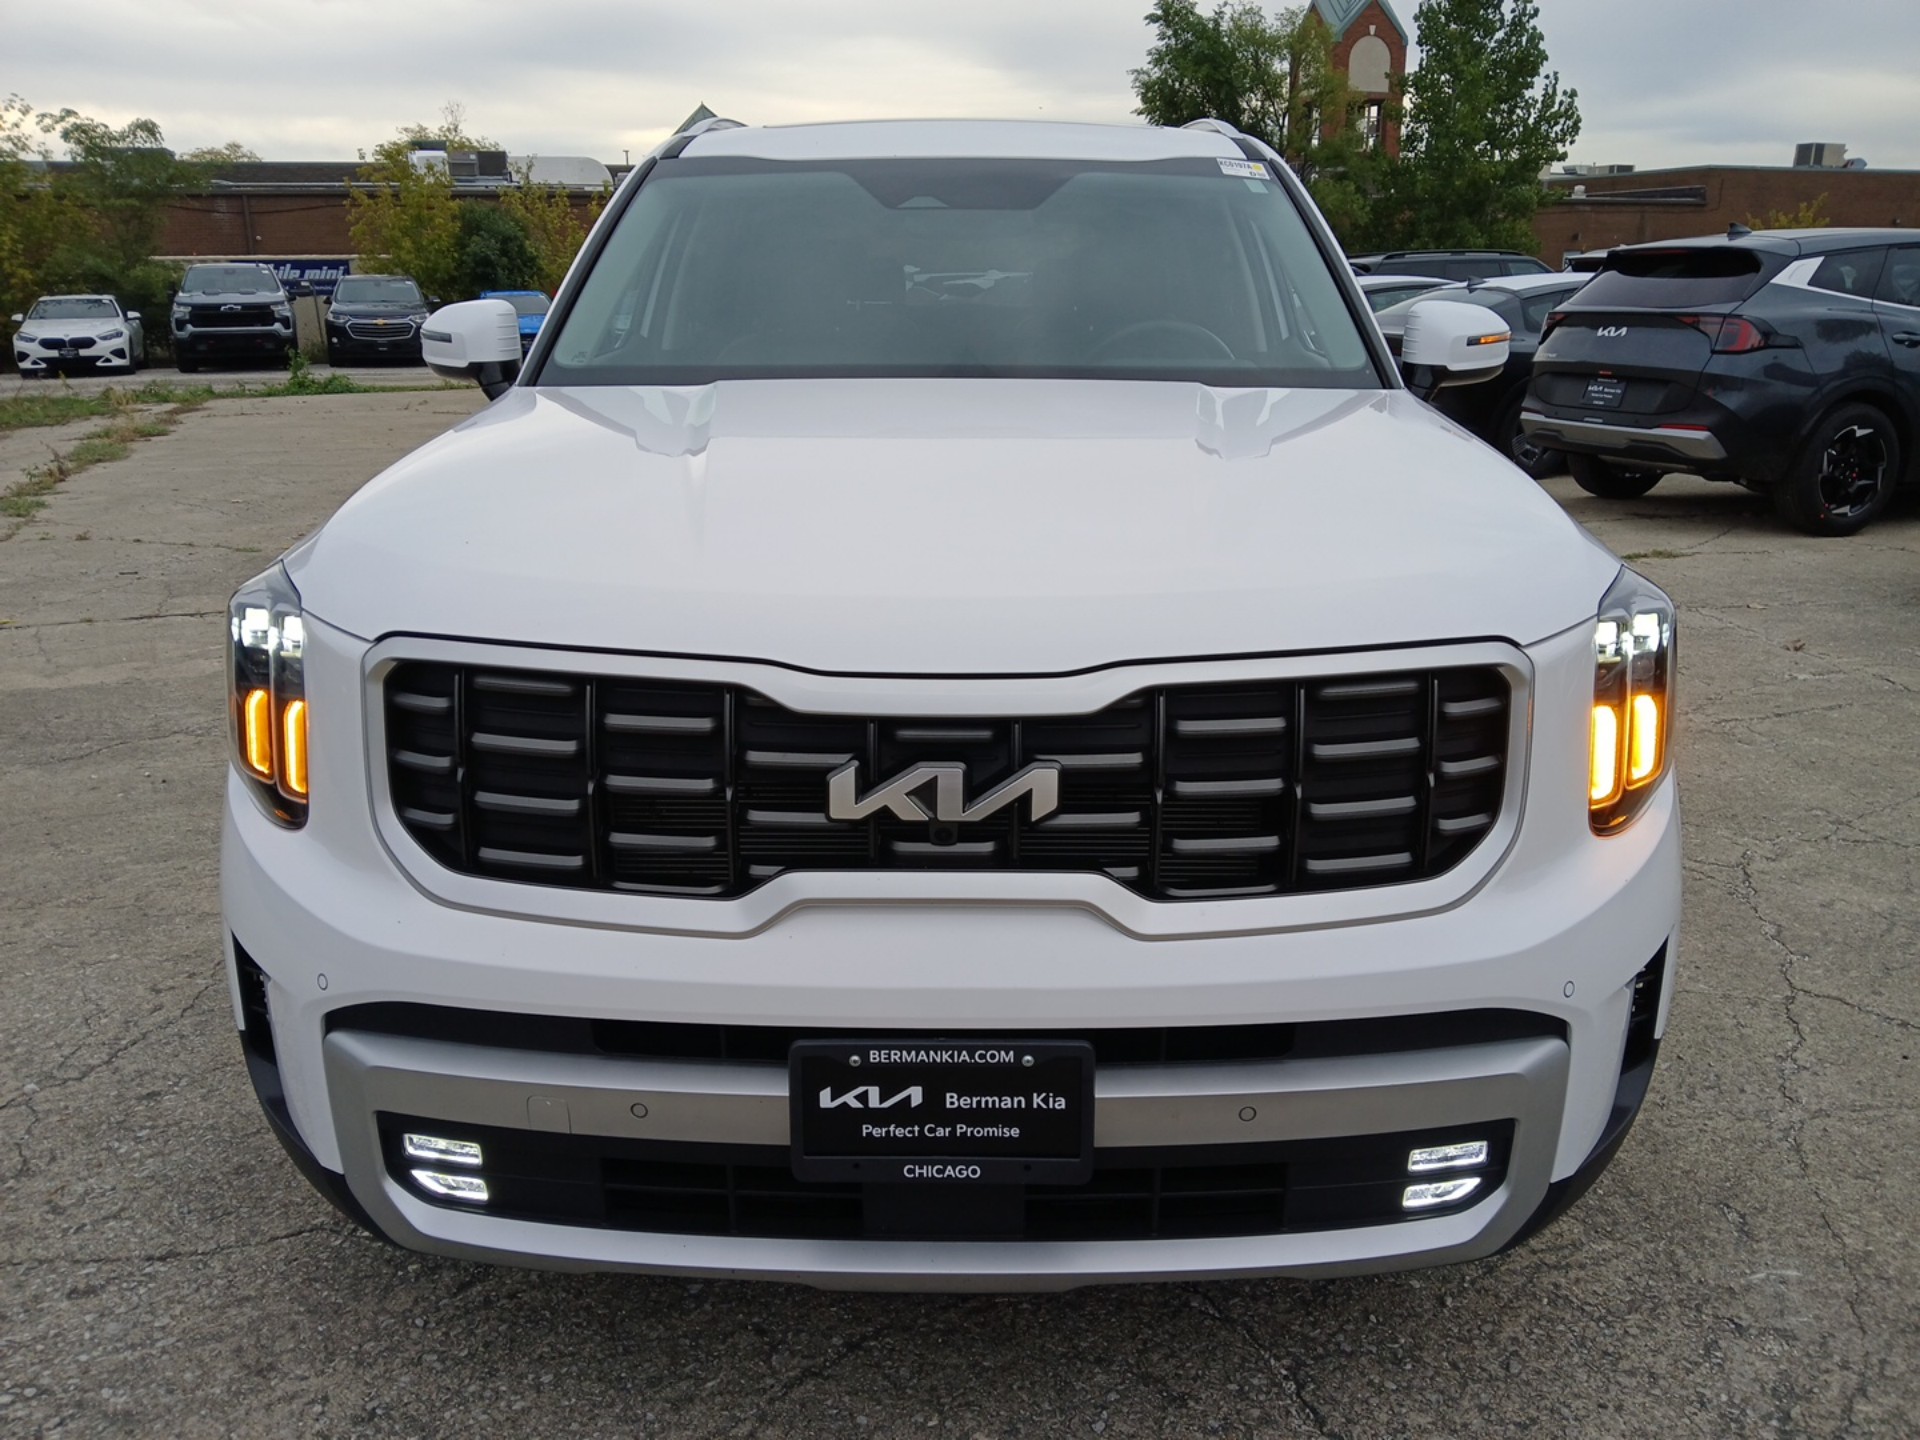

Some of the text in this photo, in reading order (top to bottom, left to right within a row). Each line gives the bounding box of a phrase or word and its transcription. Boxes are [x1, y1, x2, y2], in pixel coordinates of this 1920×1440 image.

[303, 266, 345, 280] mini
[1596, 326, 1628, 337] KIA
[827, 760, 1062, 822] KIA
[869, 1050, 1015, 1064] BERMANKIA.COM
[819, 1085, 1067, 1110] KIA Berman Kia
[862, 1123, 1021, 1138] Perfect Car Promise
[903, 1164, 982, 1179] CHICAGO
